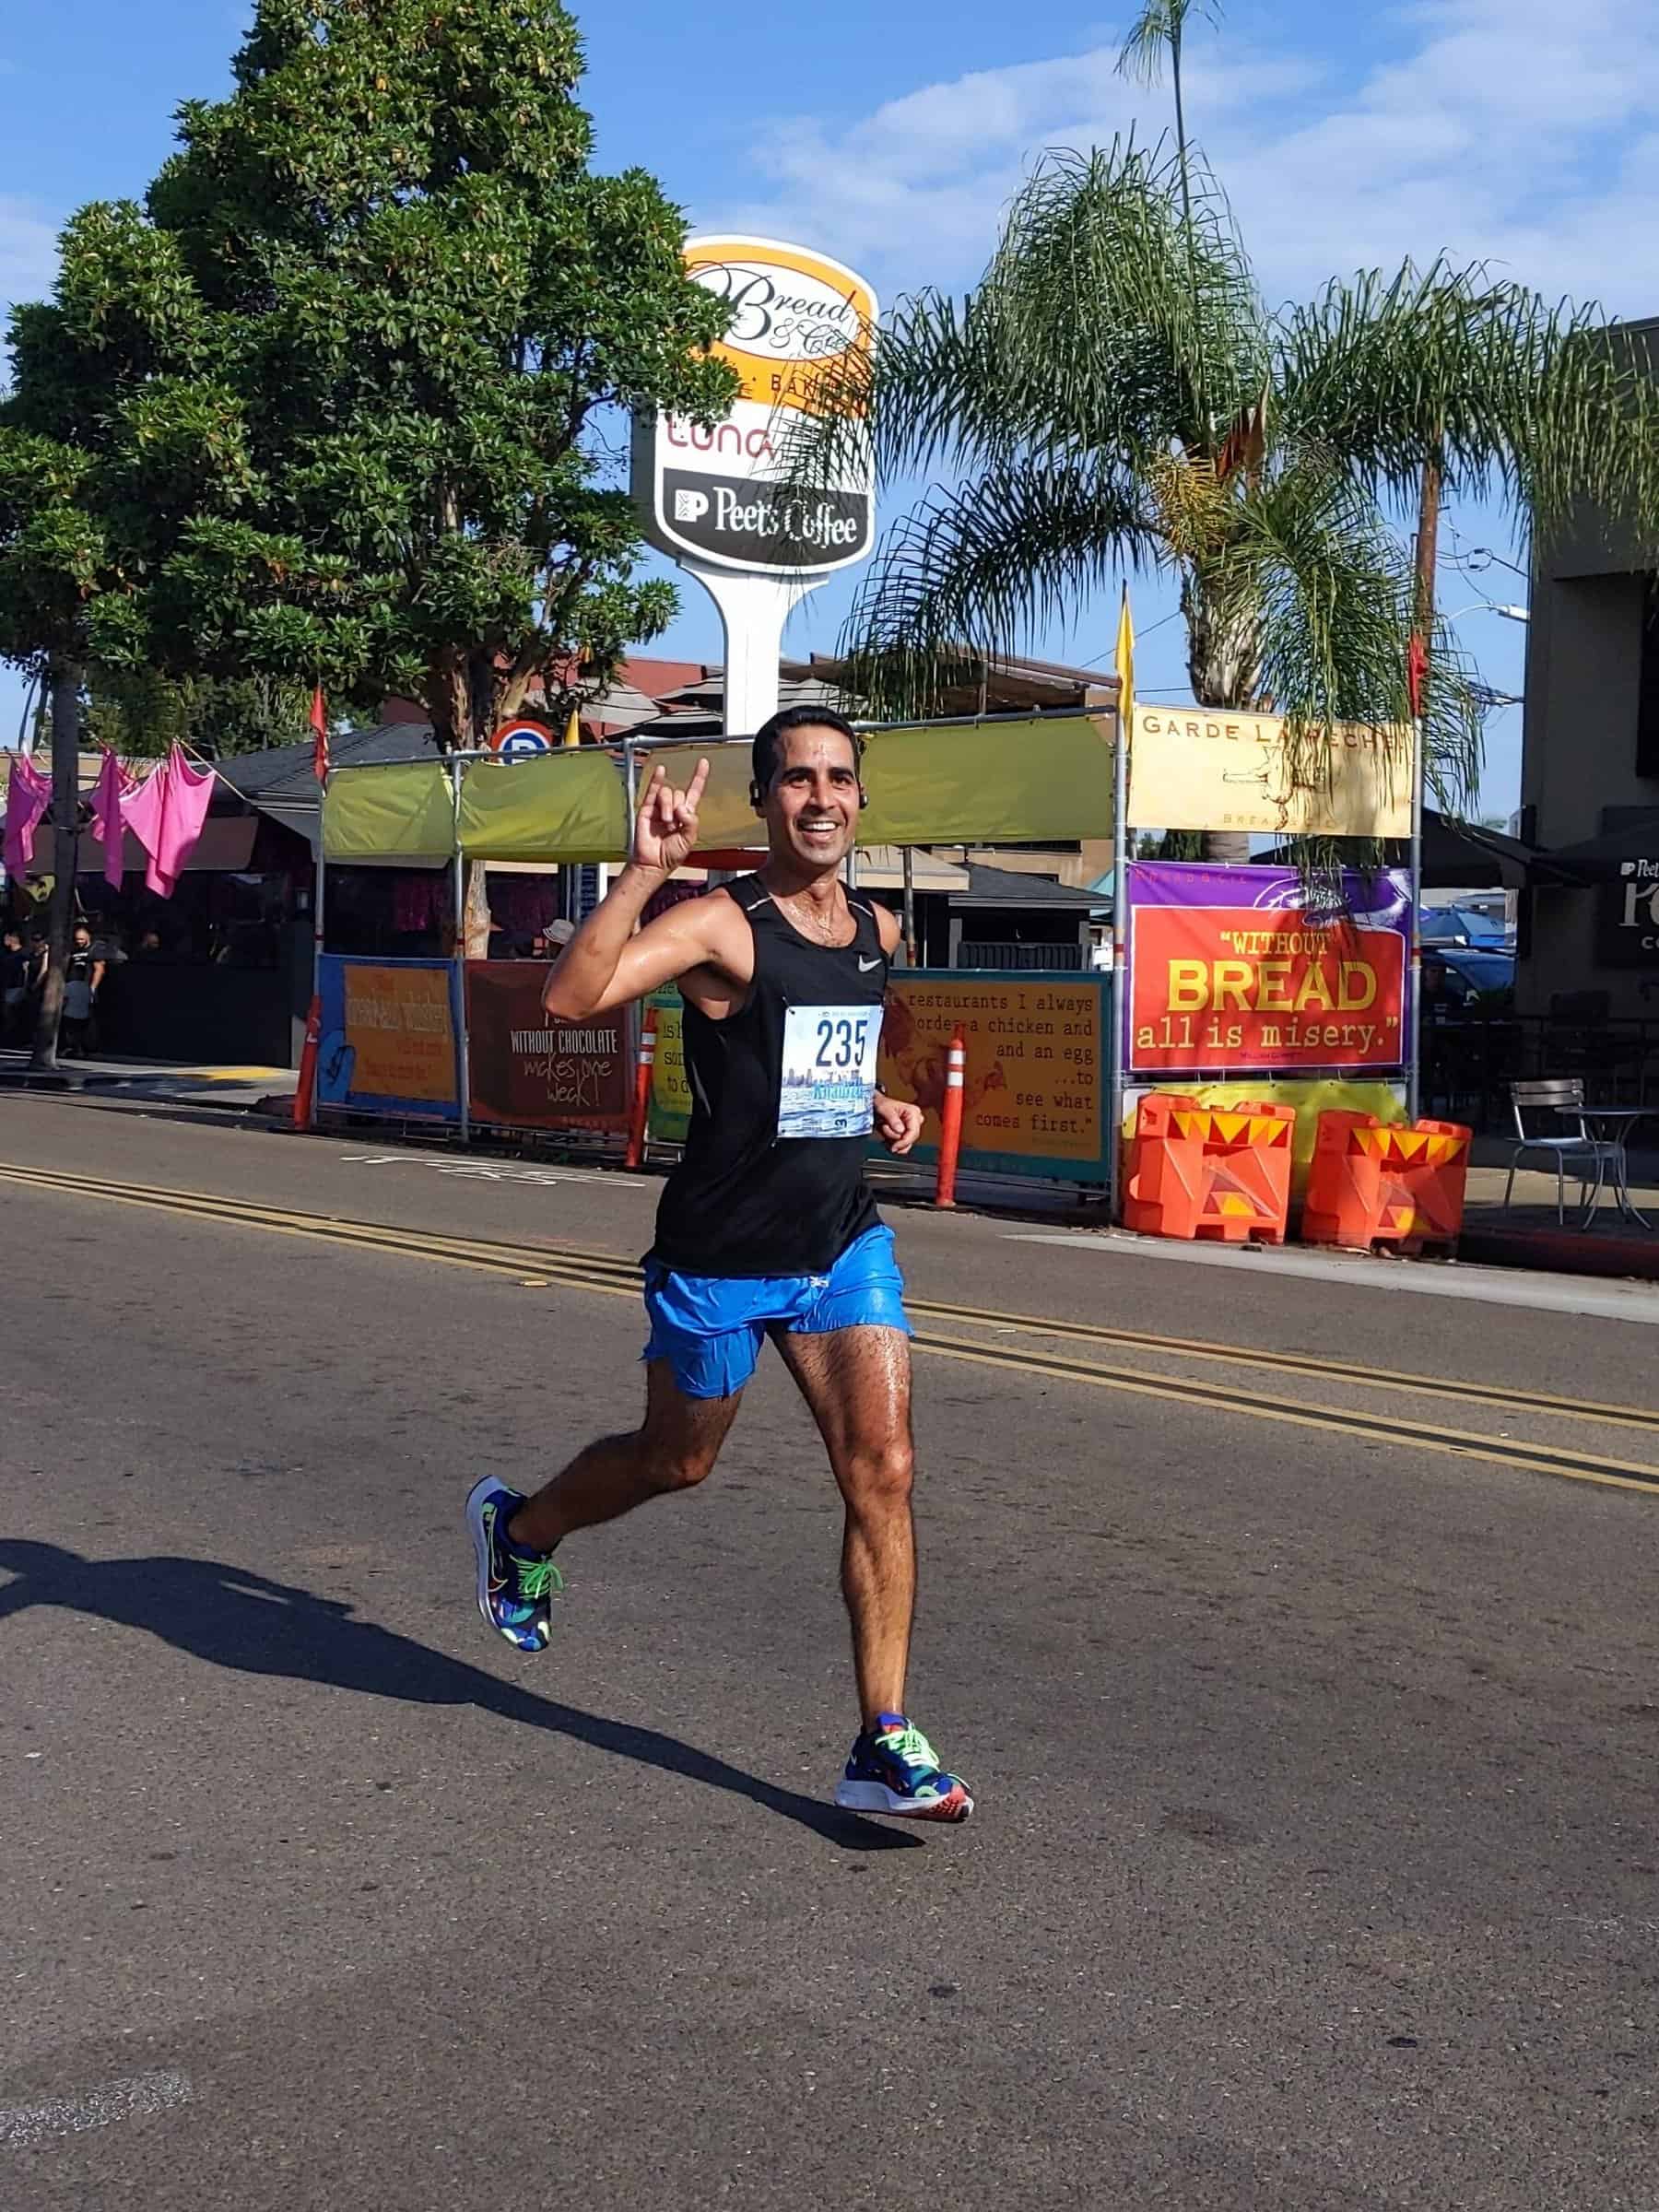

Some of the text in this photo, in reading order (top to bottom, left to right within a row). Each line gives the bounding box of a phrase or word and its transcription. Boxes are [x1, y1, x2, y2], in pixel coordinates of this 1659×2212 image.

[693, 261, 856, 341] Bread
[713, 487, 779, 537] Peet's
[784, 499, 857, 548] Coffee
[1143, 715, 1239, 739] GARDE
[1168, 959, 1377, 1011] BREAD
[909, 993, 1007, 1009] restaurants
[1018, 994, 1026, 1008] I
[1037, 994, 1092, 1016] always
[971, 1019, 978, 1031] a
[988, 1018, 1054, 1034] chicken
[1064, 1019, 1092, 1035] and
[1136, 1016, 1194, 1049] all
[1206, 1020, 1242, 1048] is
[511, 1030, 618, 1054] WITHOUT CHOCOLATE
[816, 1019, 868, 1067] 235
[996, 1042, 1093, 1065] and an egg
[1017, 1094, 1092, 1110] see what
[976, 1113, 1020, 1129] comes
